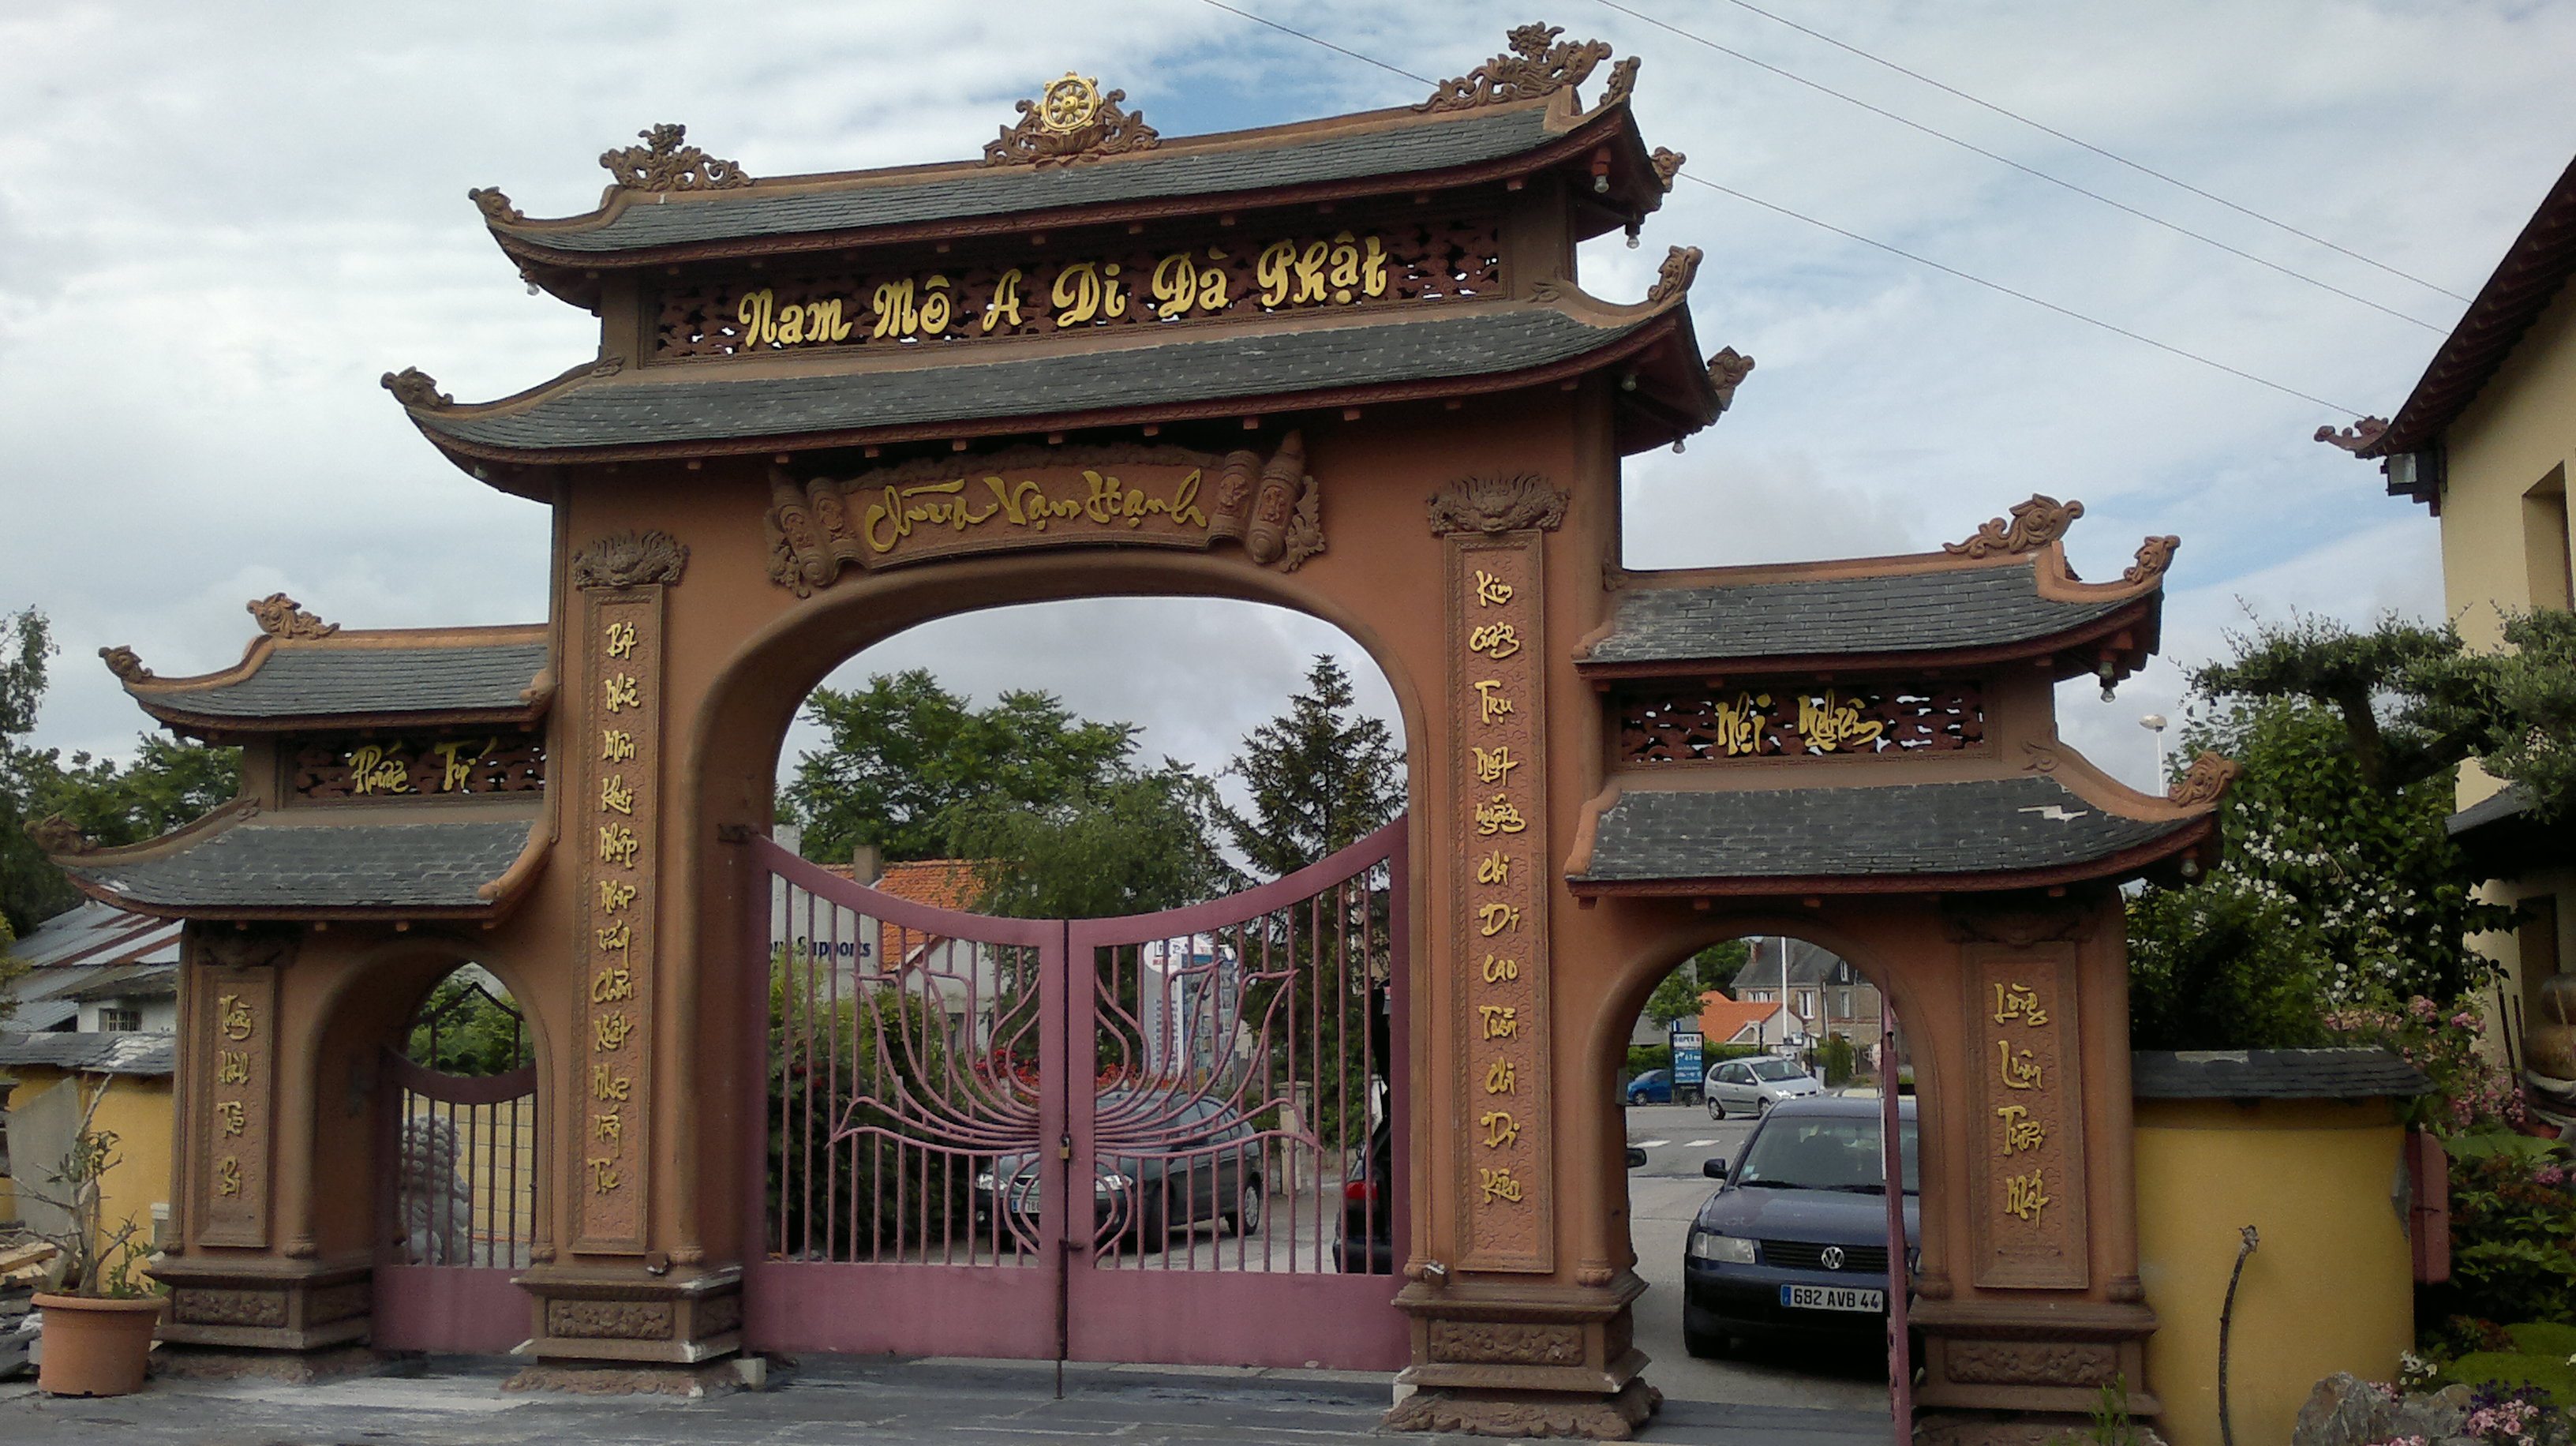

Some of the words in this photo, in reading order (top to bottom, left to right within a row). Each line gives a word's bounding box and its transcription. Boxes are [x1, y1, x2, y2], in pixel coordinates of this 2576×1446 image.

[739, 288, 850, 347] Nam
[874, 275, 951, 339] Mô
[983, 268, 1022, 332] A
[1259, 230, 1387, 308] Phật
[984, 475, 1081, 531] Vạn
[1475, 570, 1513, 607] Kim
[1477, 849, 1510, 886] Chi
[1479, 903, 1520, 936] Di
[1483, 954, 1518, 983] Cao
[1481, 1111, 1521, 1148] Di
[1794, 1288, 1822, 1306] 682
[1827, 1291, 1855, 1308] AVB
[1860, 1292, 1881, 1309] 44
